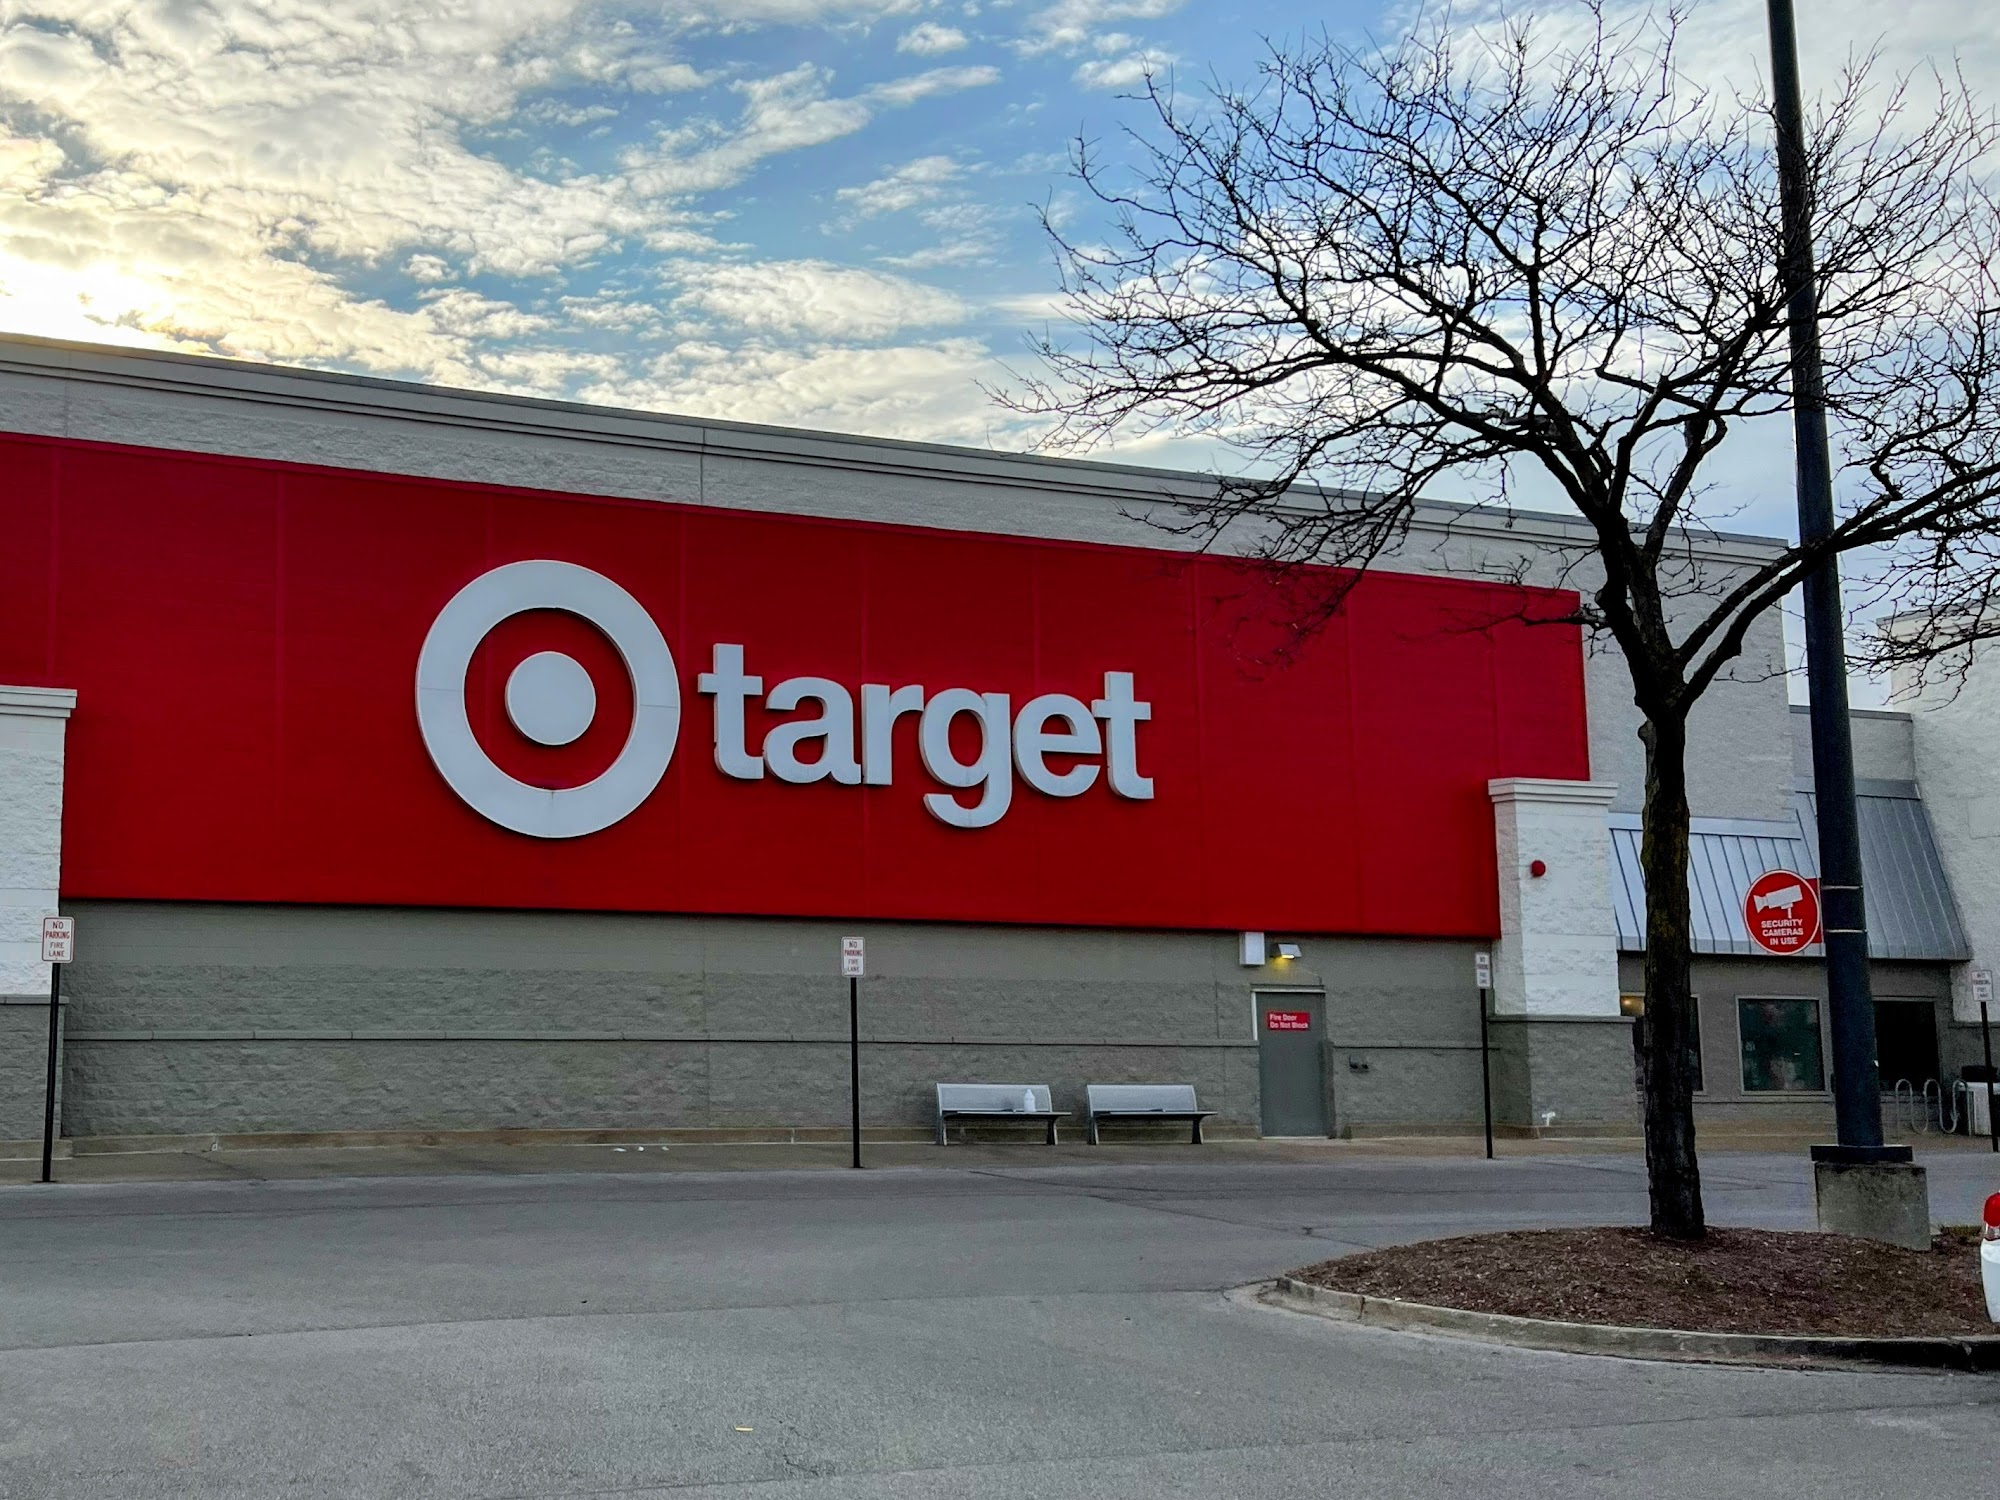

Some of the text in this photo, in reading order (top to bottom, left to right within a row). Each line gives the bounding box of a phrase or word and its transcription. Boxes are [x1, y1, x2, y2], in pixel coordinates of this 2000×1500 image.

[698, 643, 1154, 828] target
[52, 921, 64, 930] NO
[1761, 919, 1803, 928] SECURITY
[45, 930, 70, 939] PARKING
[1762, 928, 1804, 937] CAMERAS
[1769, 936, 1799, 946] IN USE
[1269, 1013, 1281, 1021] Fire
[1269, 1021, 1279, 1029] Do
